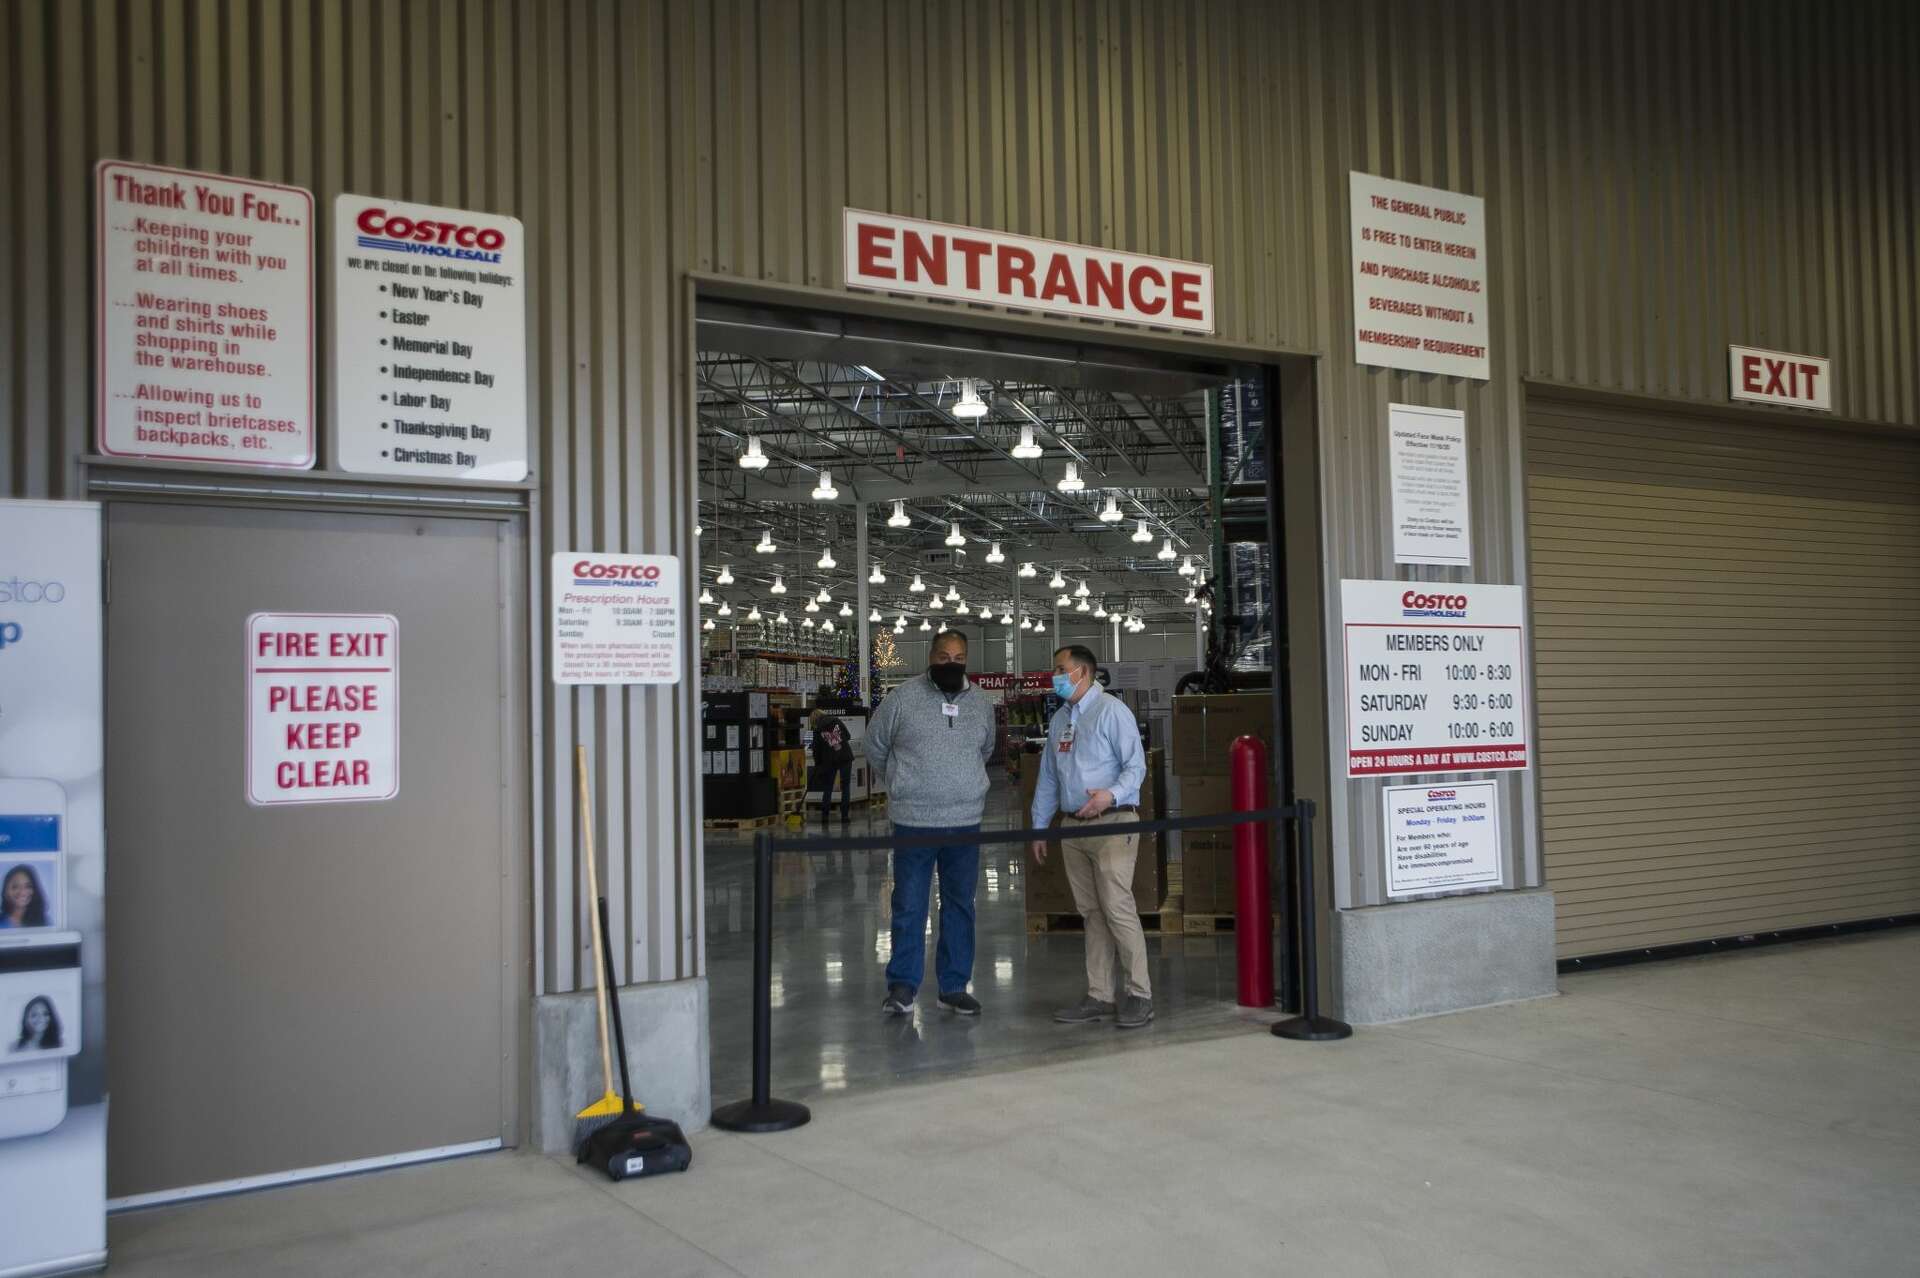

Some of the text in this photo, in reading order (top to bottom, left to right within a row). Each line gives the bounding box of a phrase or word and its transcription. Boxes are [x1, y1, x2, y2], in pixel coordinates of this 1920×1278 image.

[112, 174, 300, 226] Thank You For...
[1371, 195, 1467, 225] THE GENERAL PUBLIC
[215, 230, 254, 247] your
[357, 207, 506, 251] COSTCO
[135, 238, 287, 270] children with you
[404, 242, 502, 263] WHOLESALE
[1362, 227, 1476, 260] IS FREE TO ENTER HEREIN
[136, 257, 244, 283] at all times.
[364, 258, 380, 271] are
[382, 260, 409, 274] closed
[412, 265, 422, 276] on
[424, 265, 437, 278] the
[440, 266, 476, 284] following
[857, 223, 1204, 321] ENTRANCE
[1360, 261, 1481, 293] AND PURCHASE ALCOHOLIC
[392, 283, 484, 308] New Year's Day
[218, 303, 269, 322] shoes
[393, 308, 430, 326] Easter
[1369, 297, 1474, 324] BEVERAGES WITHOUT A
[136, 314, 277, 341] and shirts while
[136, 332, 240, 357] shopping in
[393, 336, 473, 359] Memorial Day
[1359, 329, 1486, 359] MEMBERSHIP REQUIREMENT
[136, 350, 272, 377] the warehouse.
[393, 364, 495, 388] Independence Day
[1743, 355, 1820, 400] EXIT
[221, 395, 241, 407] us
[246, 394, 262, 409] to
[393, 392, 451, 412] Labor Day
[136, 406, 302, 435] inspect briefcases,
[394, 419, 492, 442] Thanksgiving Day
[136, 426, 273, 450] backpacks, etc.
[394, 447, 477, 469] Christmas Day
[573, 560, 661, 580] COSTCO
[612, 580, 659, 588] PHARMACY
[564, 593, 670, 605] Prescription Hours
[1402, 591, 1467, 610] COSTCO
[558, 619, 589, 627] Saturday
[1424, 610, 1467, 618] WHOLESALE
[258, 632, 388, 657] FIRE EXIT
[558, 630, 584, 638] Sunday
[1386, 634, 1484, 651] MEMBERS ONLY
[1360, 664, 1390, 681] MON
[1402, 664, 1421, 681] FRI
[1445, 664, 1476, 680] 10:00
[1487, 664, 1512, 680] 8:30
[269, 685, 378, 712] PLEASE
[1361, 694, 1428, 712] SATURDAY
[1453, 694, 1477, 710] 9:30
[1488, 693, 1513, 710] 6:00
[286, 722, 361, 750] KEEP
[1361, 724, 1414, 743] SUNDAY
[1448, 722, 1479, 739] 10:00
[1489, 721, 1513, 738] 6:00
[1351, 750, 1526, 768] OPEN 24 HOURS A DAY AT WWW.COSTCO.COM
[277, 760, 370, 789] CLEAR
[1397, 802, 1486, 815] SPECIAL OPERATING HOURS
[1406, 818, 1431, 827] Monday
[1408, 833, 1435, 841] Members
